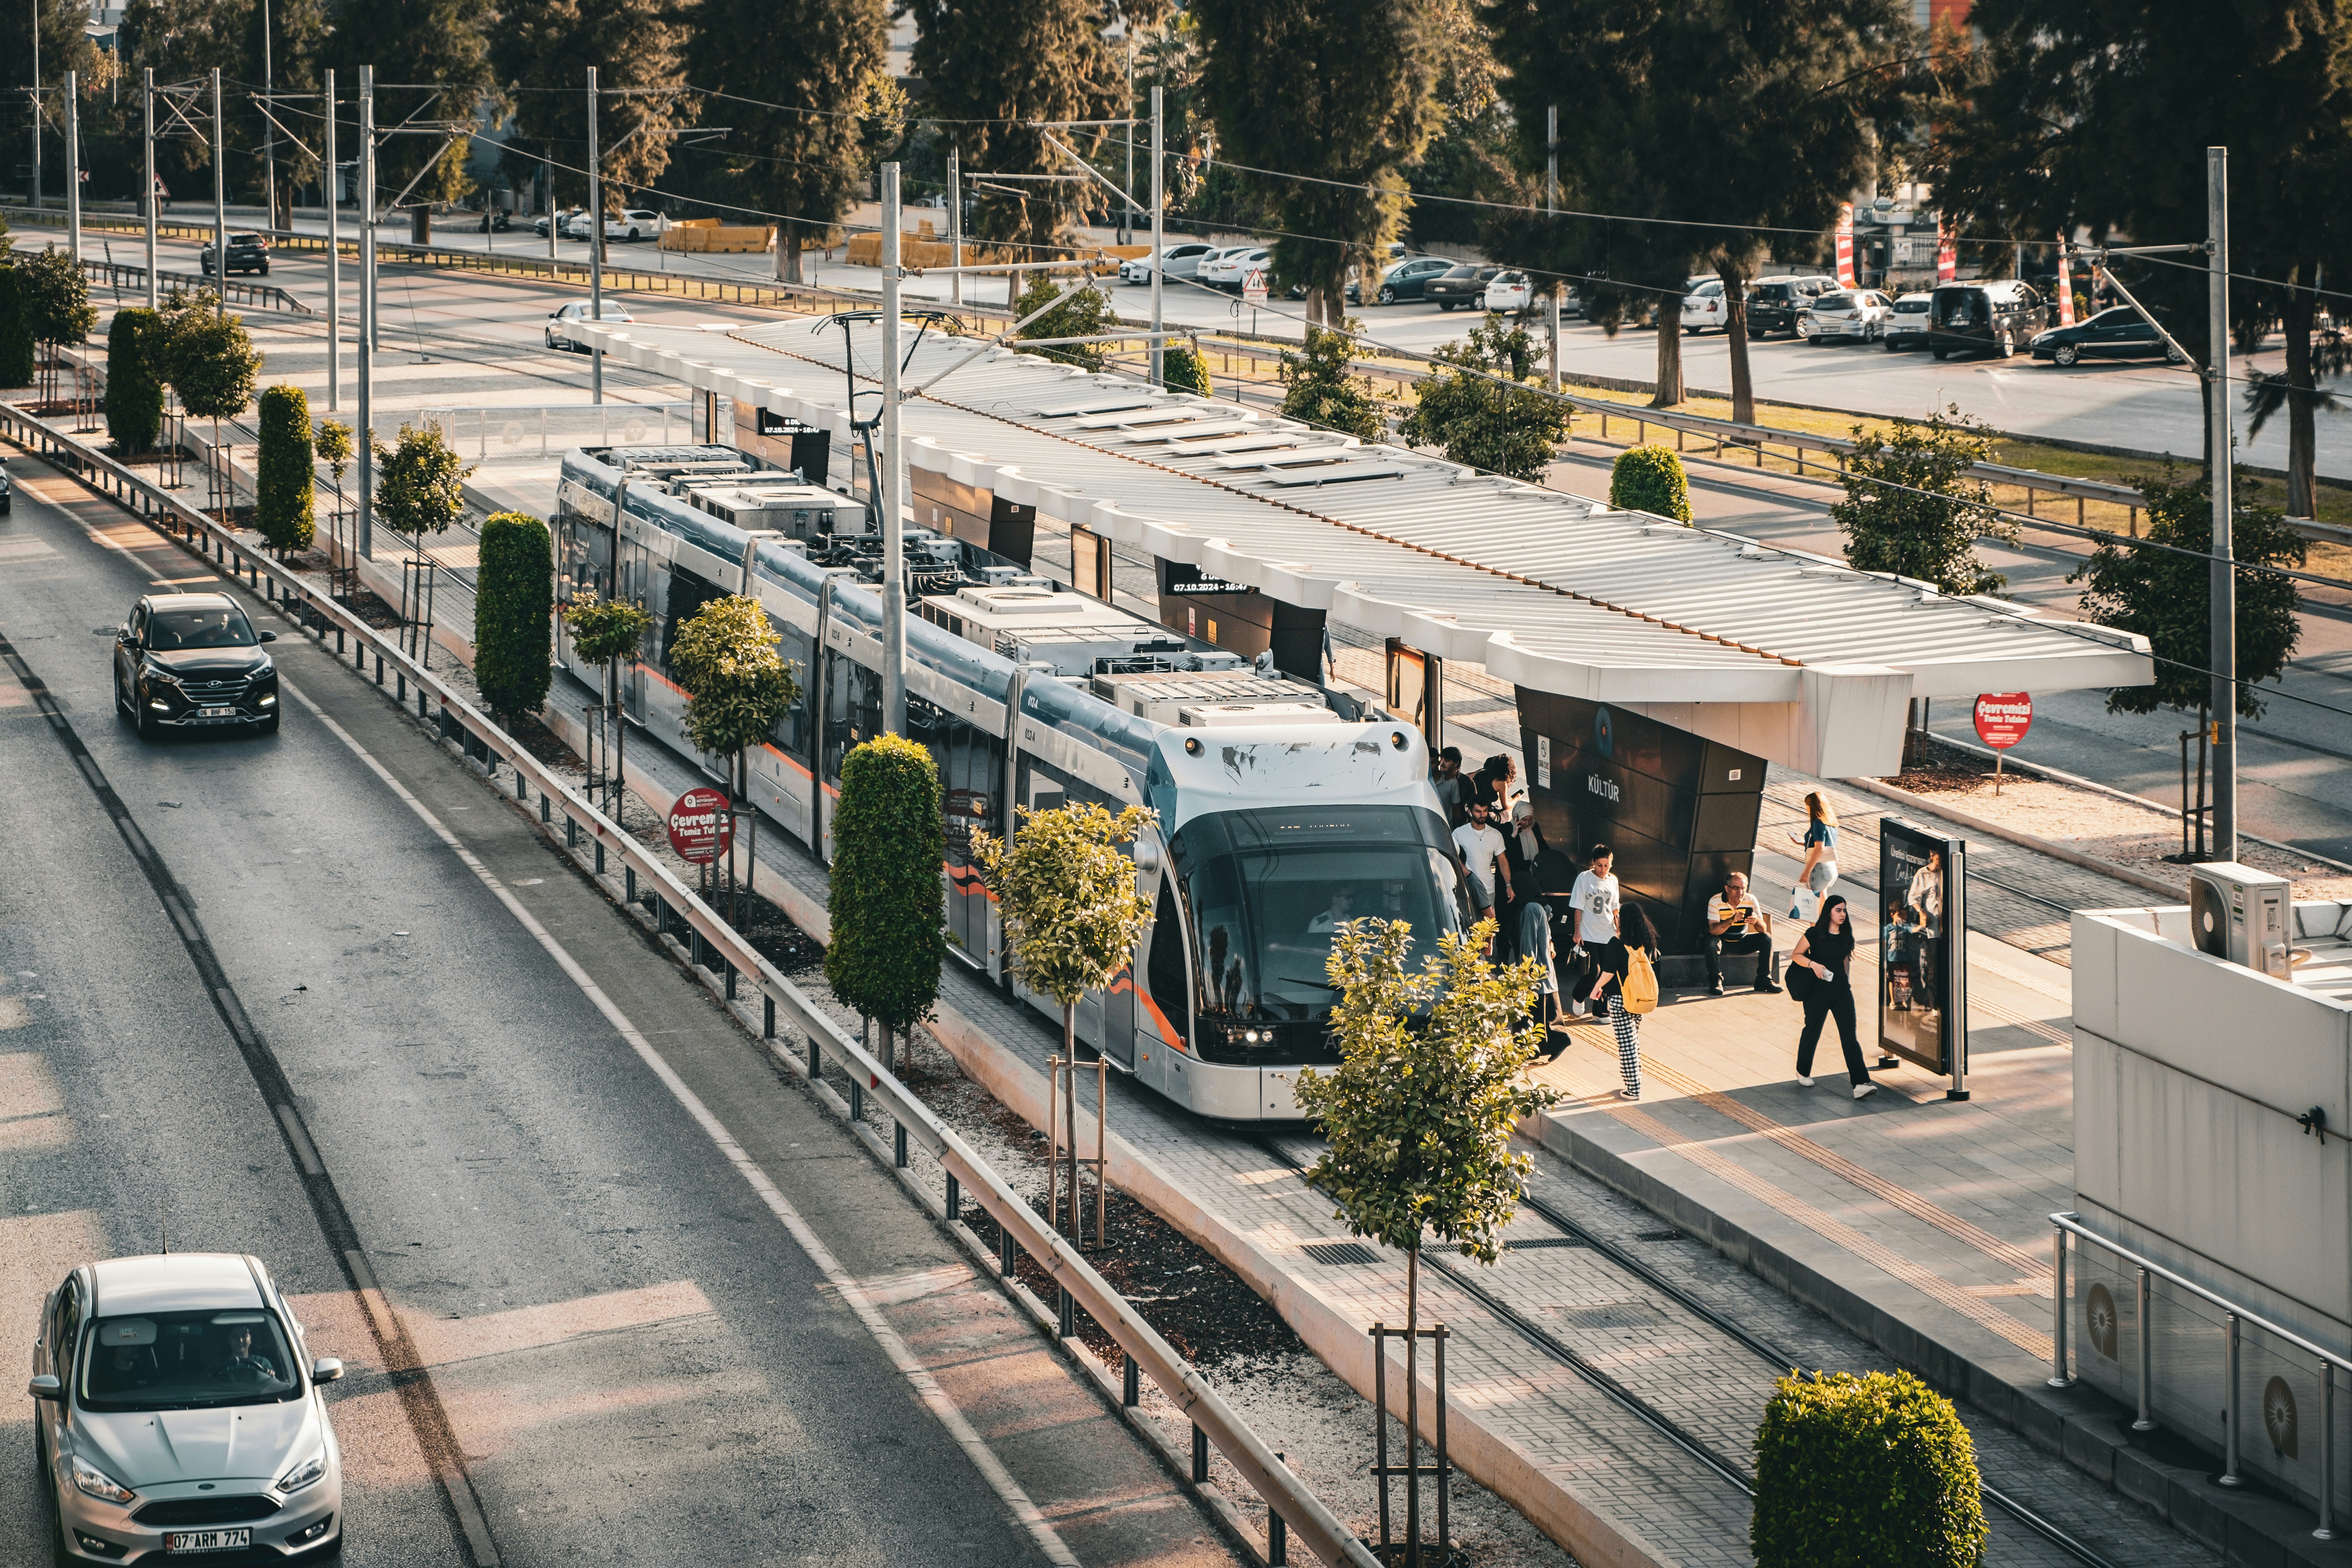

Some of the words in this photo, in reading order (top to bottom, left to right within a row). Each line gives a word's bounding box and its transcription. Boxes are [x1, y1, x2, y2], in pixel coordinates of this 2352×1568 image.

[1028, 695, 1038, 710] 012-A
[1978, 701, 2031, 716] Çevremizi
[1984, 714, 2003, 723] Temiz
[1025, 728, 1035, 742] 012-A
[1588, 773, 1619, 803] KÜLTÜR
[670, 813, 729, 831] Çevremz
[679, 827, 701, 837] Temiz
[174, 1534, 189, 1549] 07
[195, 1532, 217, 1548] ARM
[224, 1530, 248, 1546] 774
